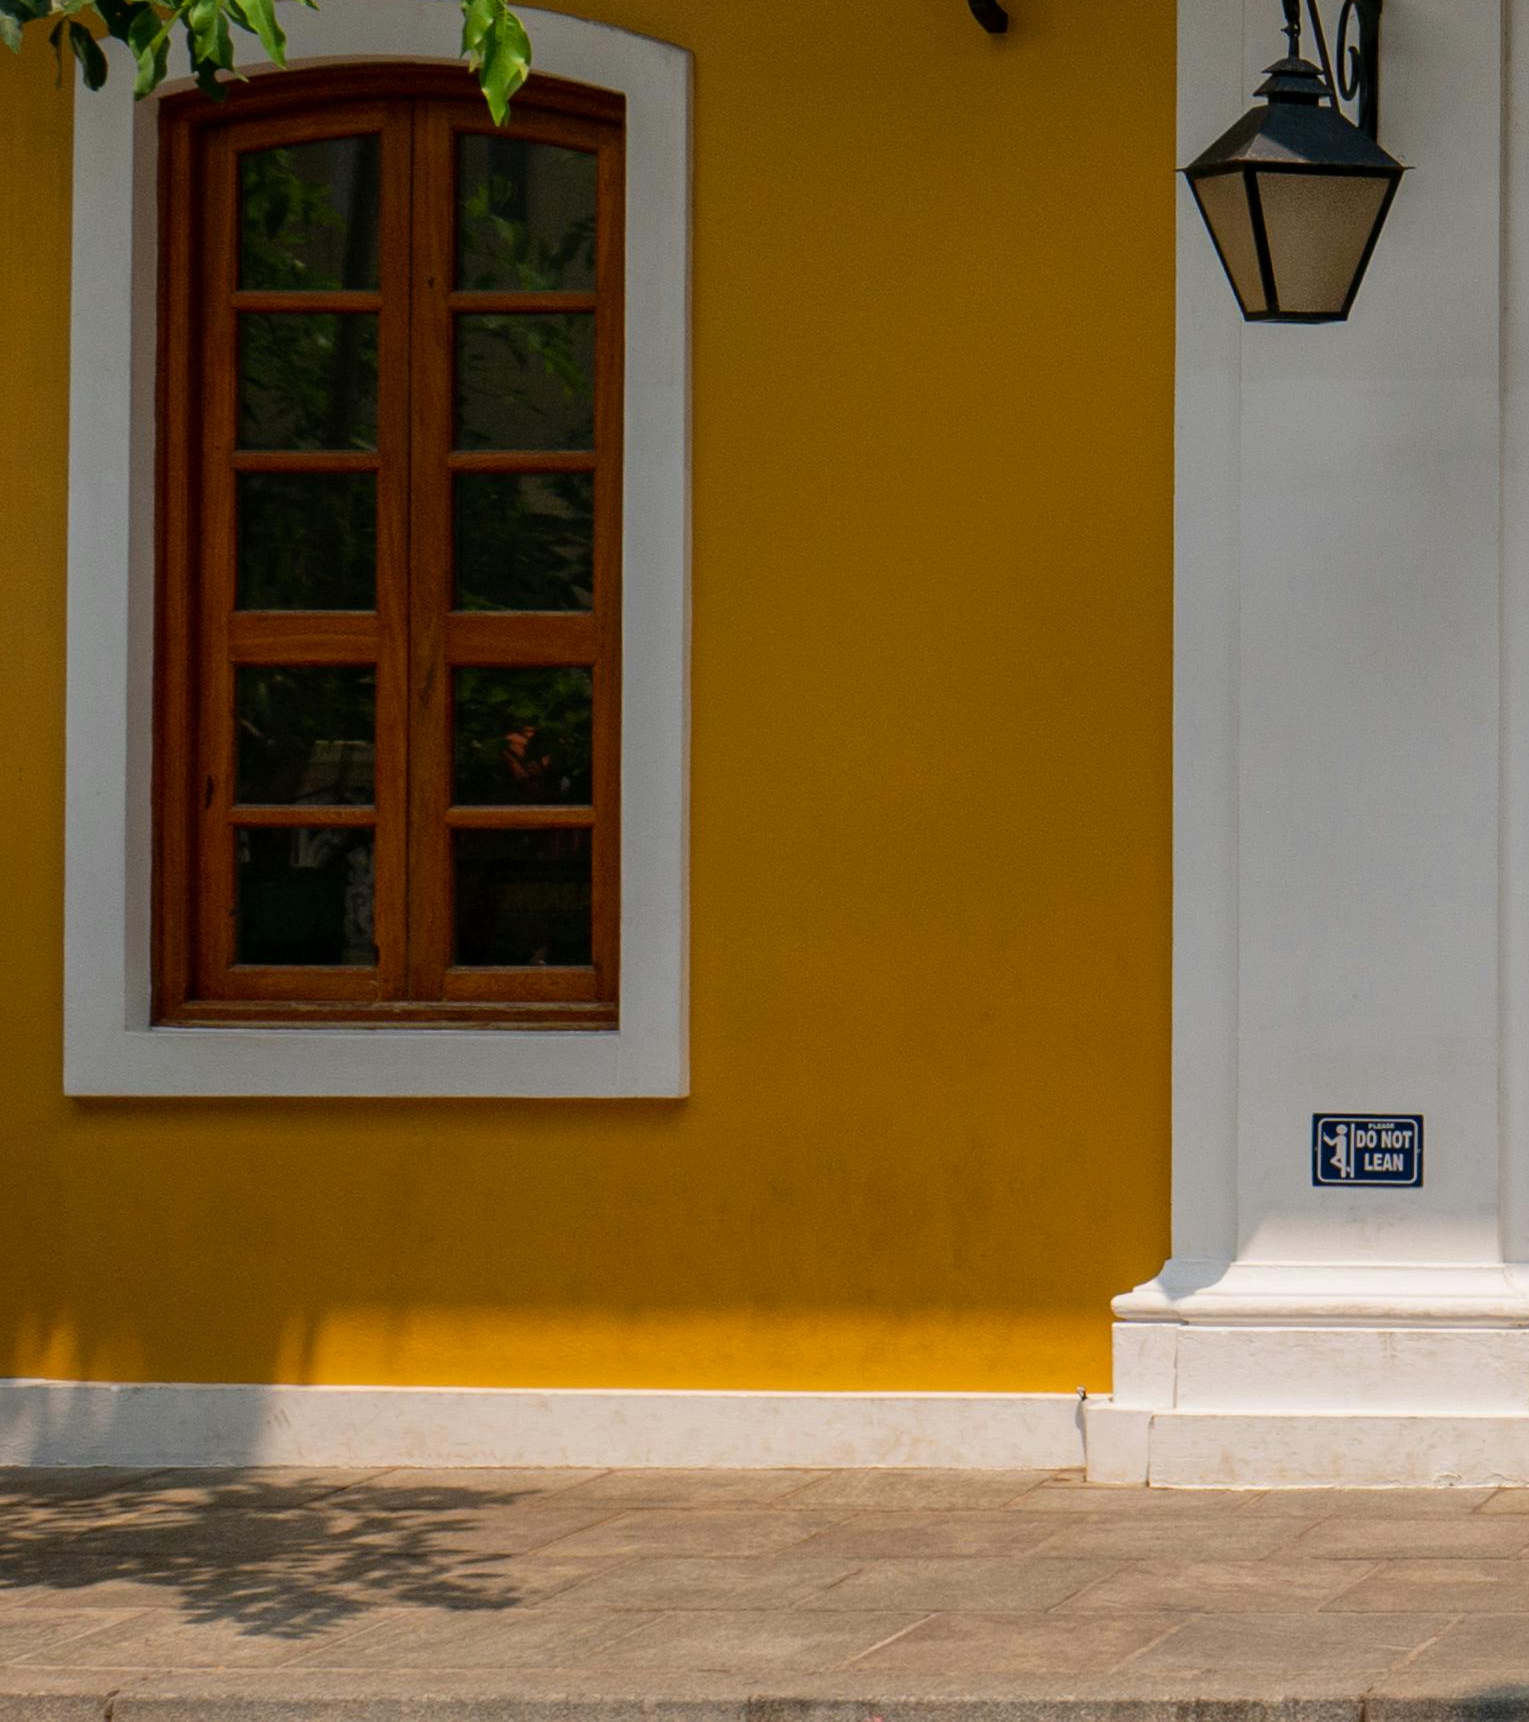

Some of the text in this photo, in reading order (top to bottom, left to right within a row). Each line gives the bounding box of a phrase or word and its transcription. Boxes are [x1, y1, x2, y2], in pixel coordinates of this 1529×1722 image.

[1356, 1130, 1412, 1149] DO NOT
[1364, 1153, 1404, 1172] LEAN
